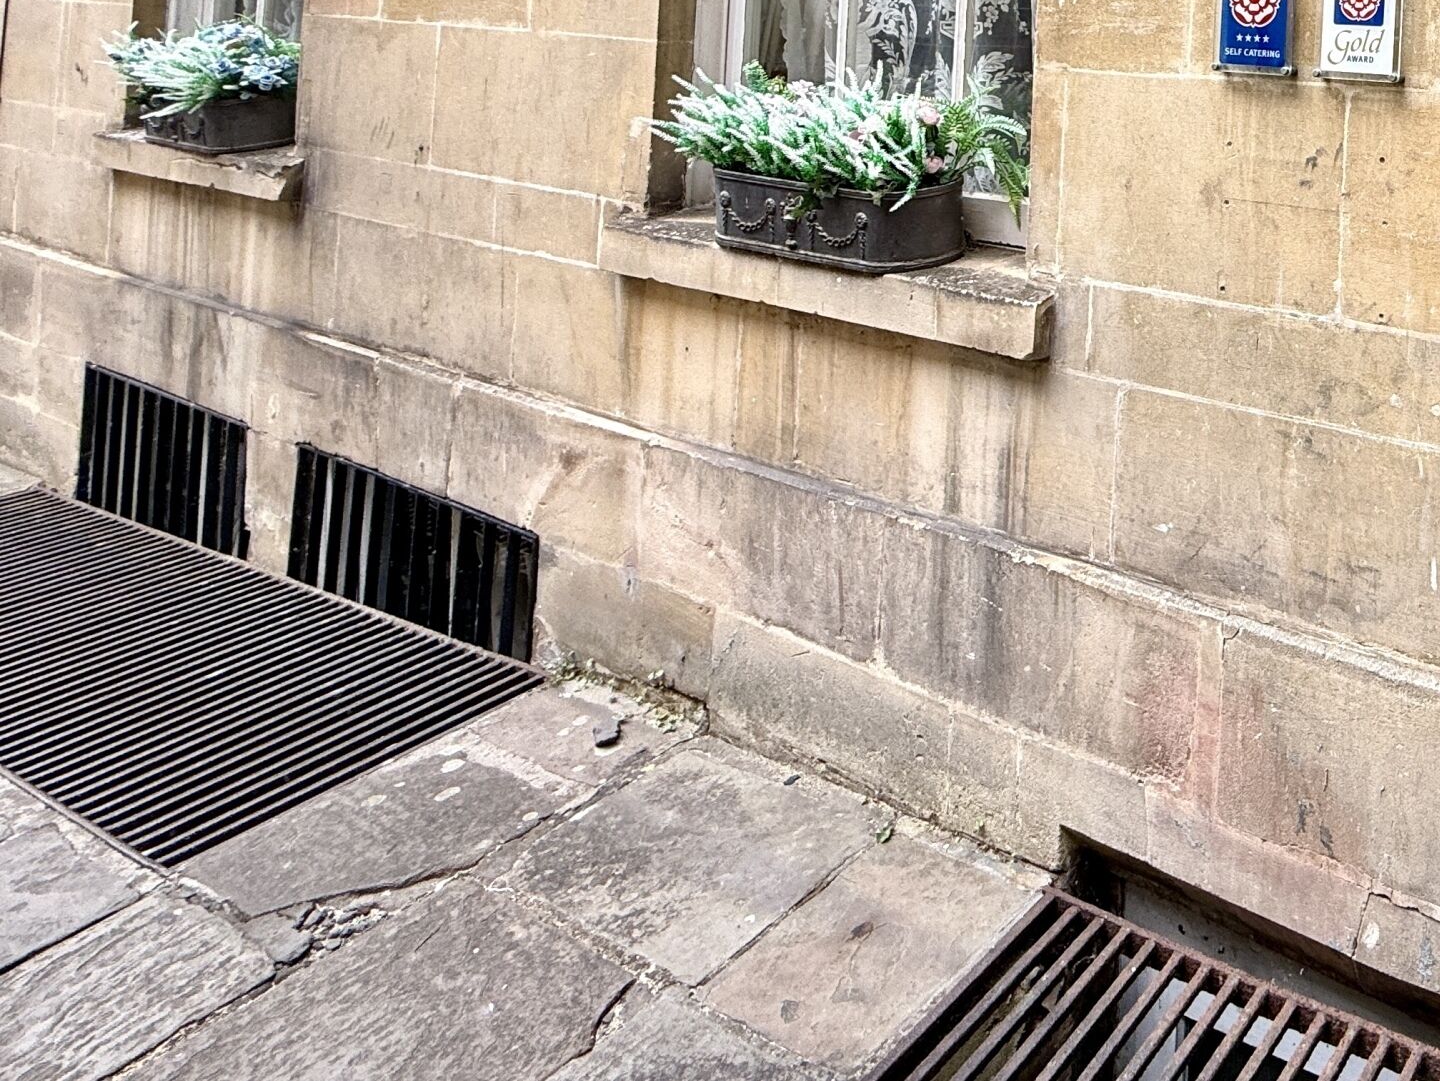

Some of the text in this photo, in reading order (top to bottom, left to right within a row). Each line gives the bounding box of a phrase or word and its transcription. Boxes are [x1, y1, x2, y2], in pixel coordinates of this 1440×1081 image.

[1224, 47, 1281, 58] SELF CATERING
[1327, 29, 1386, 65] Gold
[1346, 55, 1374, 64] AWARD
